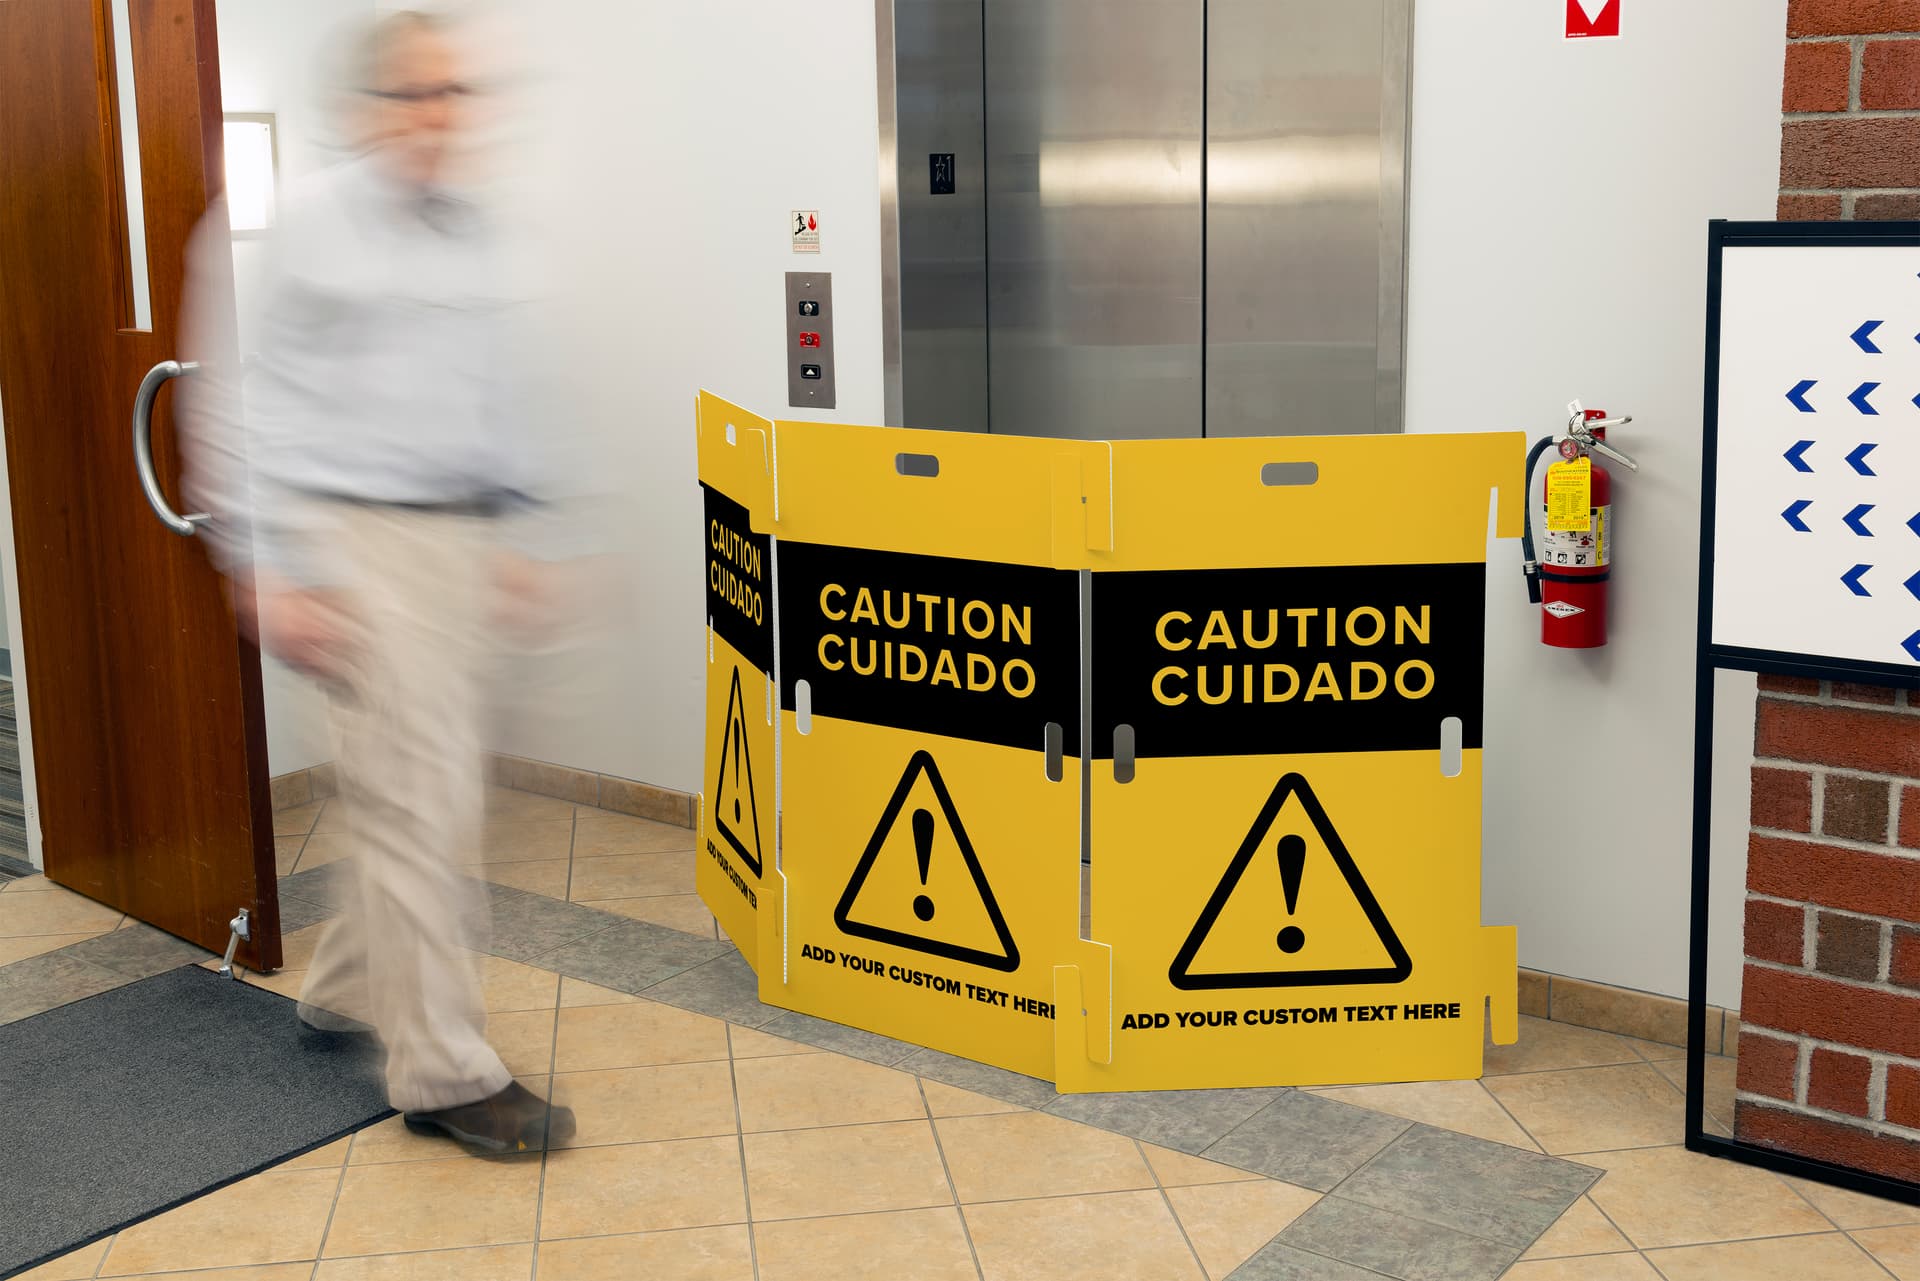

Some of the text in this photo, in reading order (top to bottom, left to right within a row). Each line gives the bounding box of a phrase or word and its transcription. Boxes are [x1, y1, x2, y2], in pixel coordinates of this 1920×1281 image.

[712, 519, 760, 582] CAUTION
[711, 560, 762, 626] CUIDADO
[820, 583, 1031, 645] CAUTION
[1155, 605, 1431, 651] CAUTION
[818, 633, 1036, 698] CUIDADO
[1152, 660, 1435, 706] CUIDADO
[707, 837, 716, 859] ADD
[729, 865, 748, 900] CUSTOM
[801, 943, 836, 964] ADD
[839, 952, 885, 977] YOUR
[889, 965, 961, 996] CUSTOM
[965, 983, 1009, 1007] TEXT
[1121, 1002, 1461, 1030] ADD YOUR CUSTOM TEXT HERE
